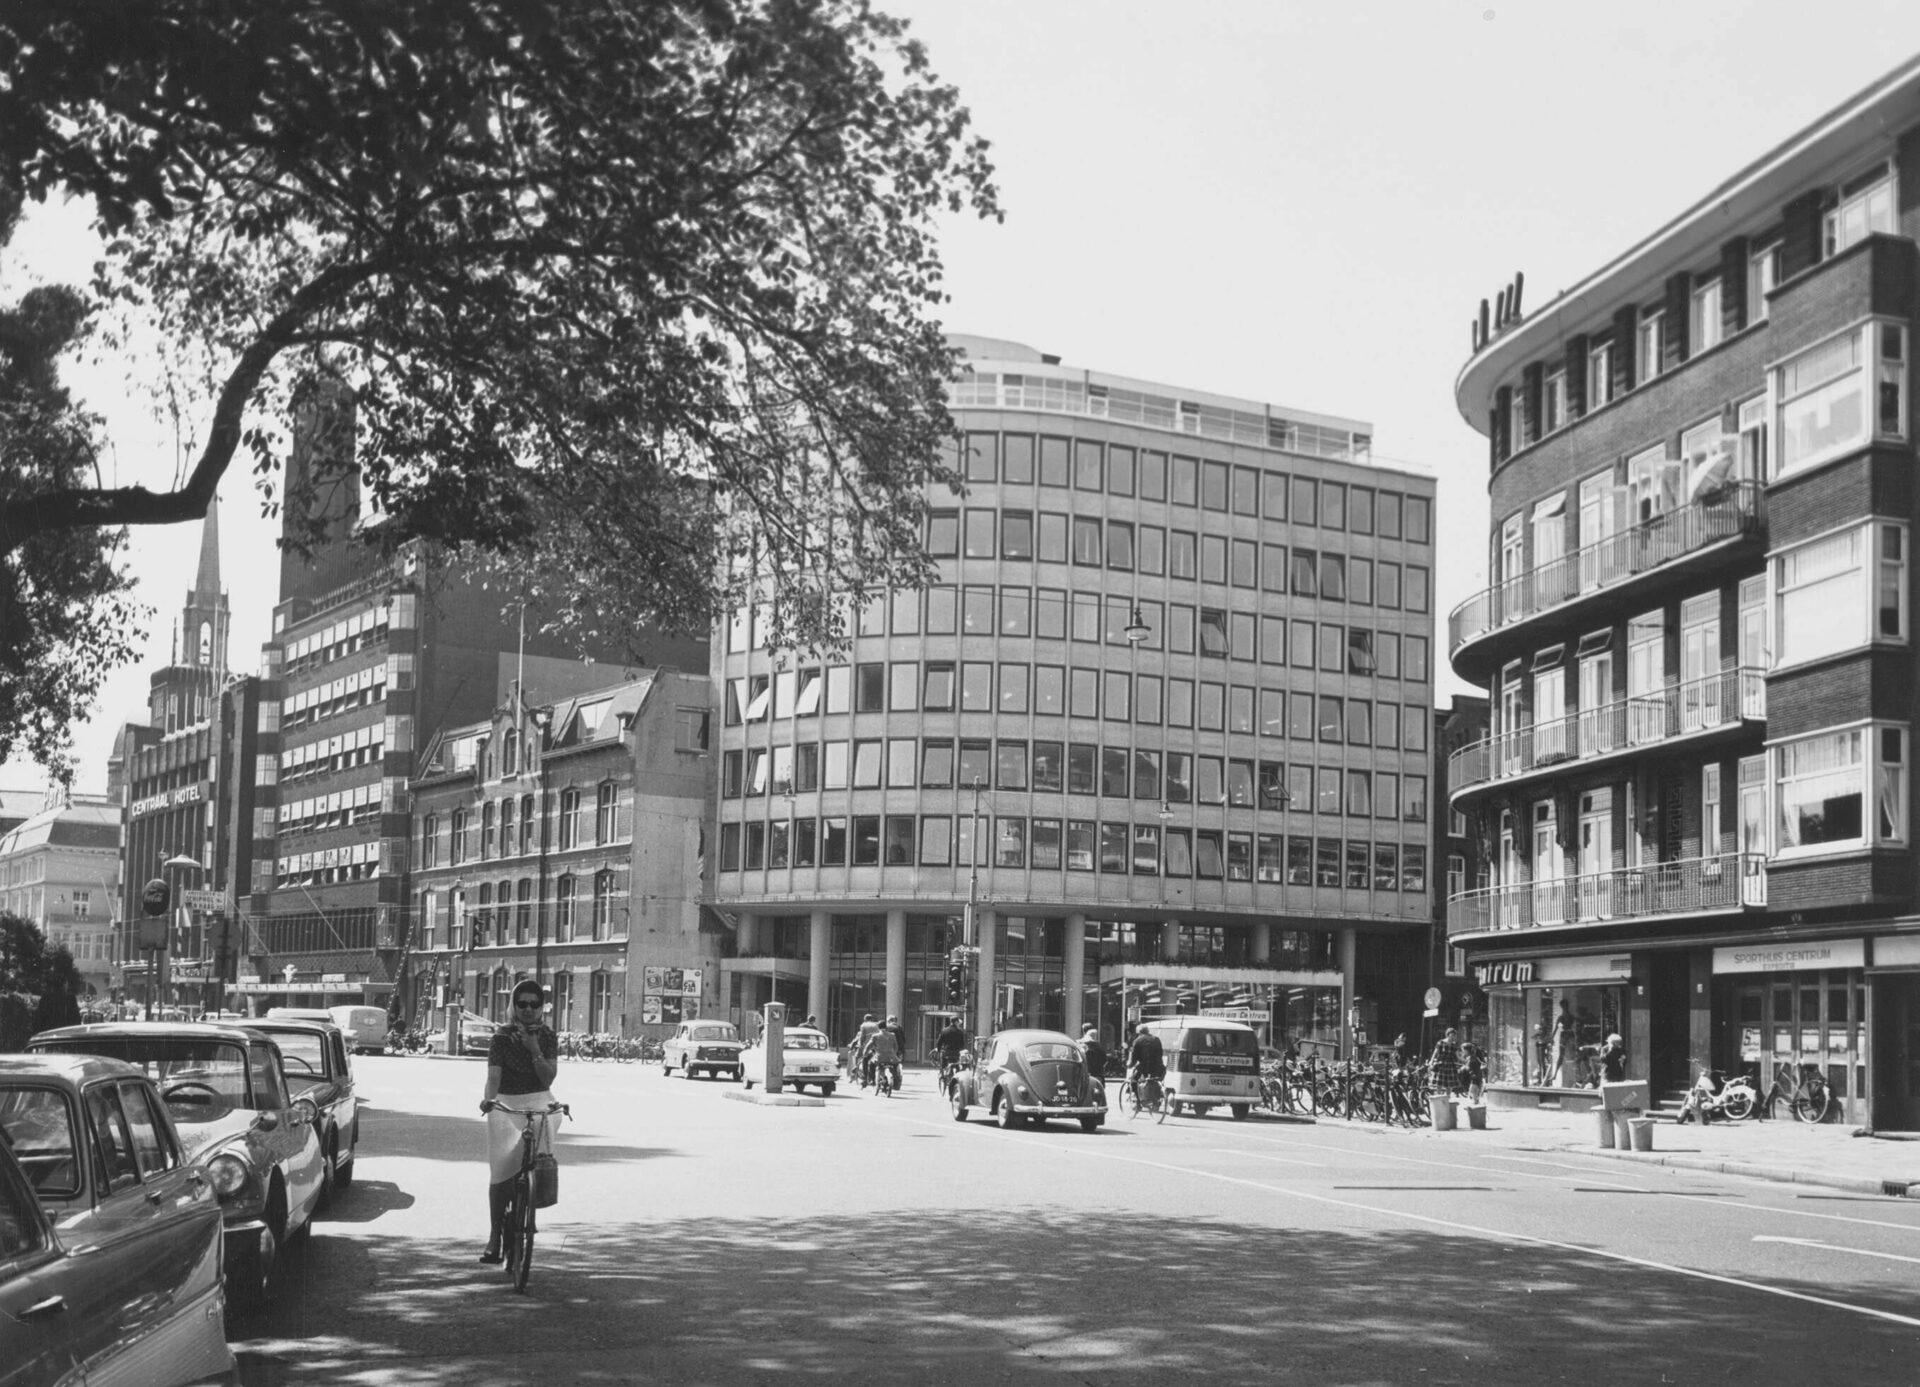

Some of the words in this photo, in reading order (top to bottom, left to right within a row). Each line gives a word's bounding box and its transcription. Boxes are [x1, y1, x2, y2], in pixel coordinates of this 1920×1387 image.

[132, 792, 169, 816] CENTRAAL
[174, 784, 200, 805] HOTEL
[1734, 951, 1784, 964] SPORTHUIS
[1785, 949, 1831, 961] CENTRUM
